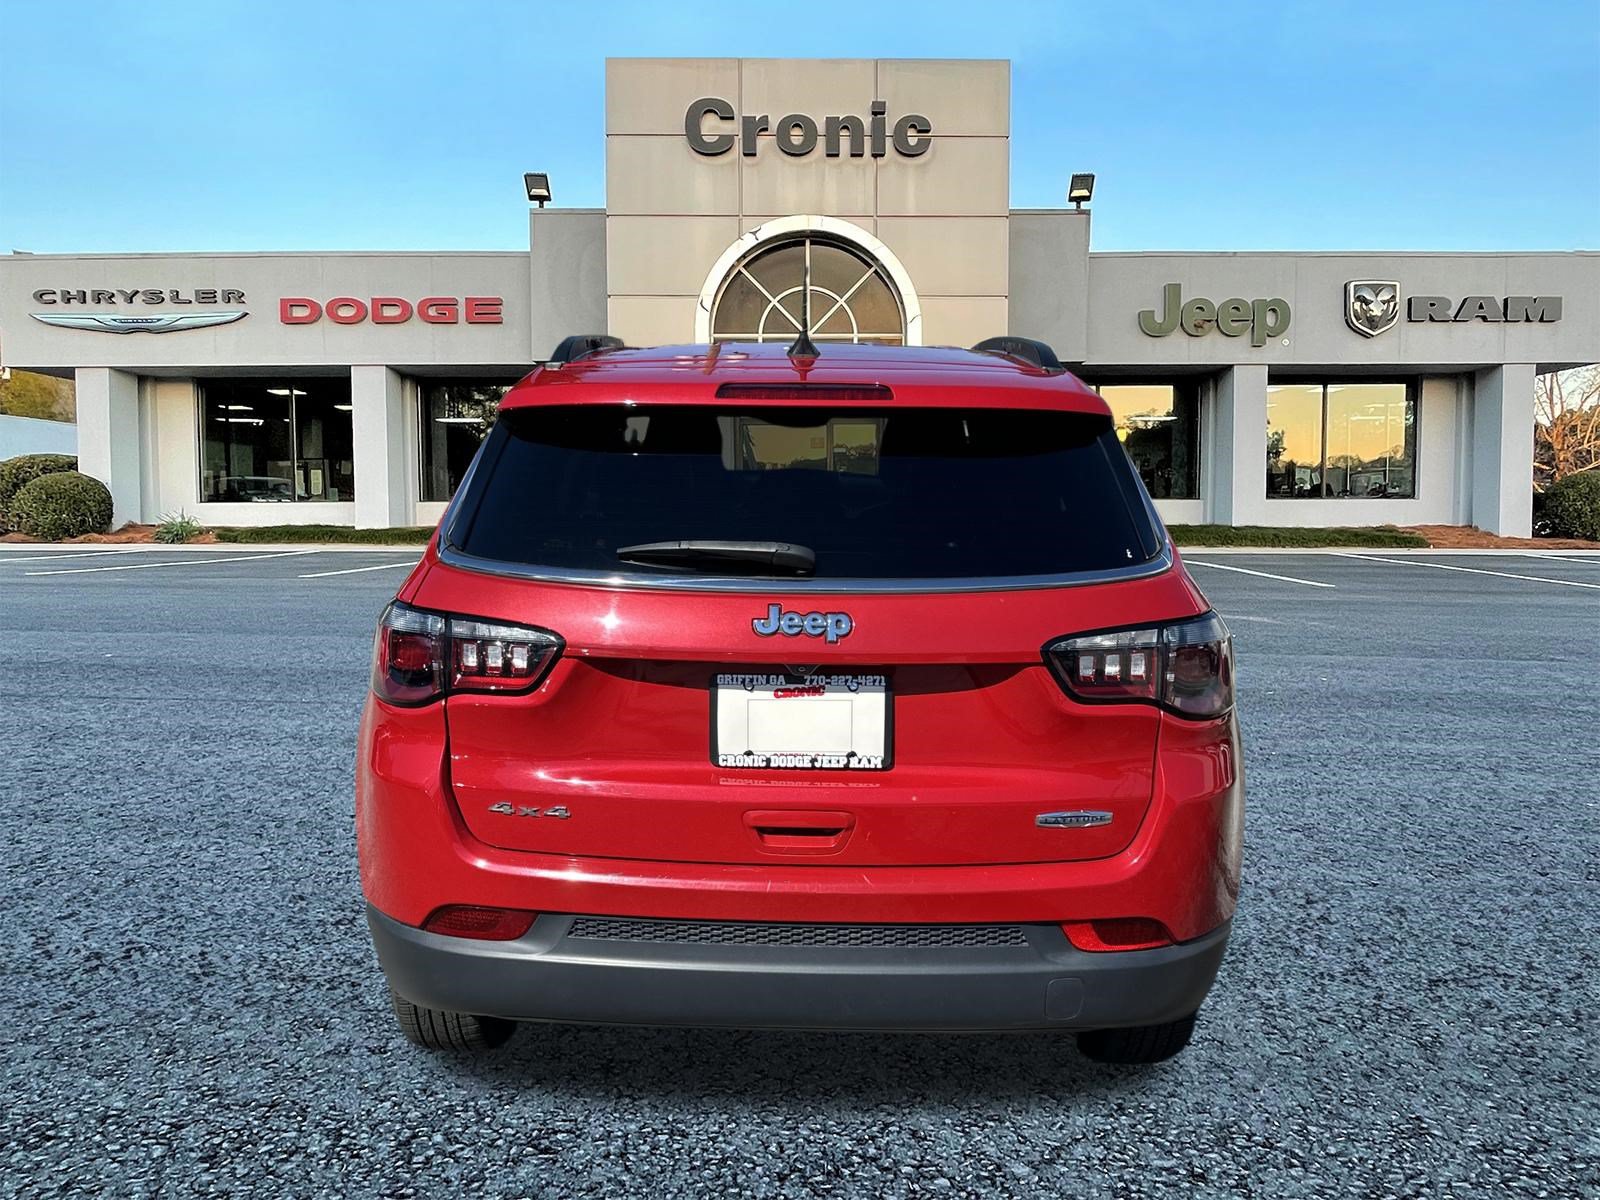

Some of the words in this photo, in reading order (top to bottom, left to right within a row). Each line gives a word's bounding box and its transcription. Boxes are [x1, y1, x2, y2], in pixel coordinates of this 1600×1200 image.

[685, 97, 932, 158] Cronic
[32, 288, 247, 305] CHRYSLER
[1407, 296, 1563, 322] RAM
[279, 297, 504, 325] DODGE
[1138, 283, 1292, 348] Jeep
[752, 603, 854, 644] Jeep
[716, 674, 767, 686] GRIFFIN
[769, 675, 786, 686] GA
[803, 675, 886, 686] 770-227-4271
[718, 754, 767, 767] CRONIC
[769, 756, 812, 768] DODGE
[814, 756, 847, 768] JEEP
[848, 757, 882, 769] RAM
[488, 801, 571, 820] 4x4
